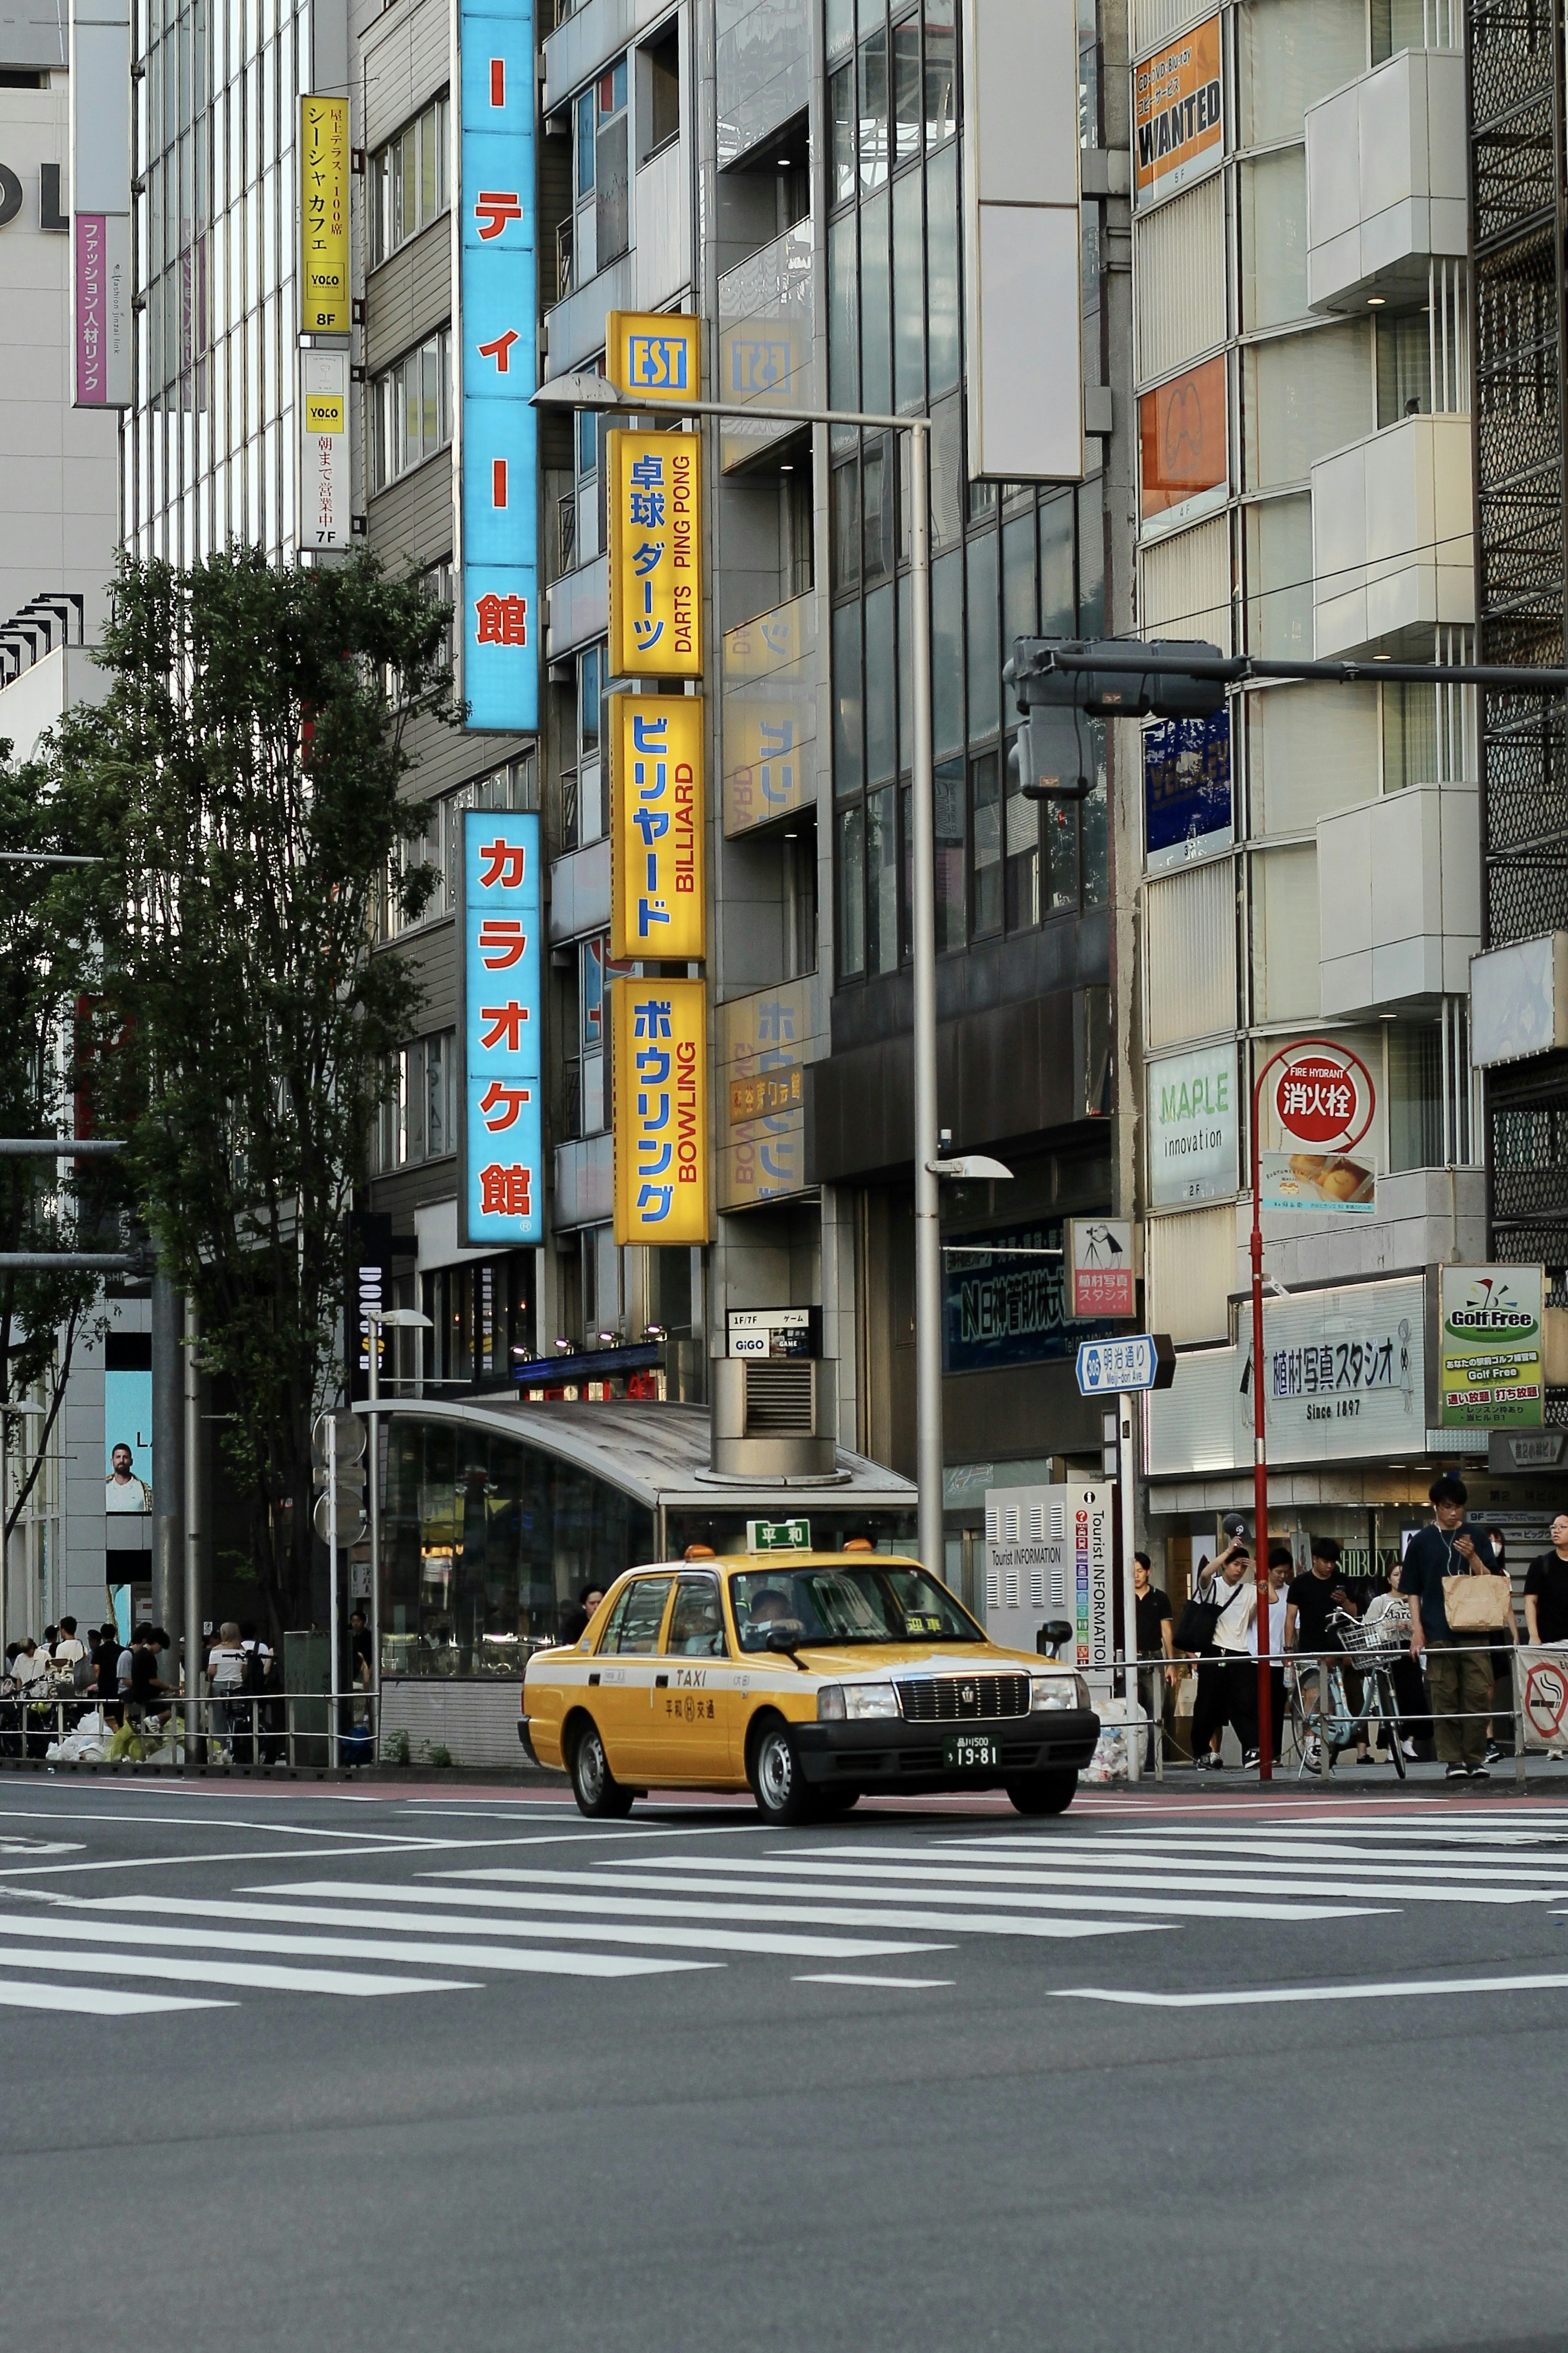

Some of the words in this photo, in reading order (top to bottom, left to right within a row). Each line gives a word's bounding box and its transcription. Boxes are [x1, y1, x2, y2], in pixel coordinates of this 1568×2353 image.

[1138, 77, 1180, 116] コピーサービス
[1137, 77, 1221, 171] WANTED
[307, 107, 327, 250] シーシャカフェ
[311, 274, 340, 285] YOLO
[83, 223, 100, 392] ファッション人材リンク
[316, 313, 336, 326] 8F
[634, 339, 684, 385] EST
[310, 407, 338, 418] YOLO
[318, 436, 333, 529] 朝まで営業中
[630, 454, 666, 529] 卓球
[673, 455, 691, 513] PONG
[315, 530, 337, 544] 7F
[673, 519, 691, 568] PING
[632, 542, 665, 652] ダーツ
[675, 585, 692, 654] DARTS
[633, 716, 671, 937] ビリヤード
[675, 763, 695, 893] BILLIARD
[478, 837, 533, 1217] カラオケ館
[1290, 1066, 1308, 1078] FIRE
[1309, 1067, 1344, 1080] HYDRANT
[1159, 1071, 1229, 1125] MAPLE
[1283, 1081, 1351, 1119] 消火栓
[634, 999, 675, 1223] ボウリング
[676, 1040, 697, 1183] BOWLING
[1164, 1127, 1223, 1159] innovation
[1189, 1184, 1200, 1196] 2F
[1078, 1274, 1128, 1287] 植村写真
[733, 1315, 758, 1325] 1F/7F
[783, 1314, 804, 1323] ゲーム
[1451, 1311, 1490, 1326] Golf
[1491, 1311, 1532, 1326] Free
[735, 1340, 764, 1351] GiGO
[1104, 1344, 1145, 1371] 明治通り
[1087, 1359, 1100, 1377] 305
[1106, 1371, 1131, 1386] Meiji-dori
[1132, 1371, 1144, 1381] Ave.
[1272, 1337, 1393, 1399] 植村写真スタジオ
[1468, 1370, 1490, 1380] Golf
[1493, 1367, 1517, 1378] Free
[1447, 1390, 1490, 1406] 通い放題
[1495, 1386, 1539, 1402] 打ち放題
[1306, 1403, 1332, 1421] Since
[1335, 1399, 1361, 1418] 1897
[136, 1431, 152, 1448] L
[761, 1526, 803, 1542] 平和
[1093, 1510, 1105, 1560] Tourist
[992, 1550, 1013, 1567] Tourist
[1014, 1547, 1061, 1566] INFORMATION
[676, 1669, 707, 1687] TAXI
[665, 1699, 683, 1718] 平和
[697, 1700, 715, 1719] 交通
[958, 1746, 996, 1765] 19-81
